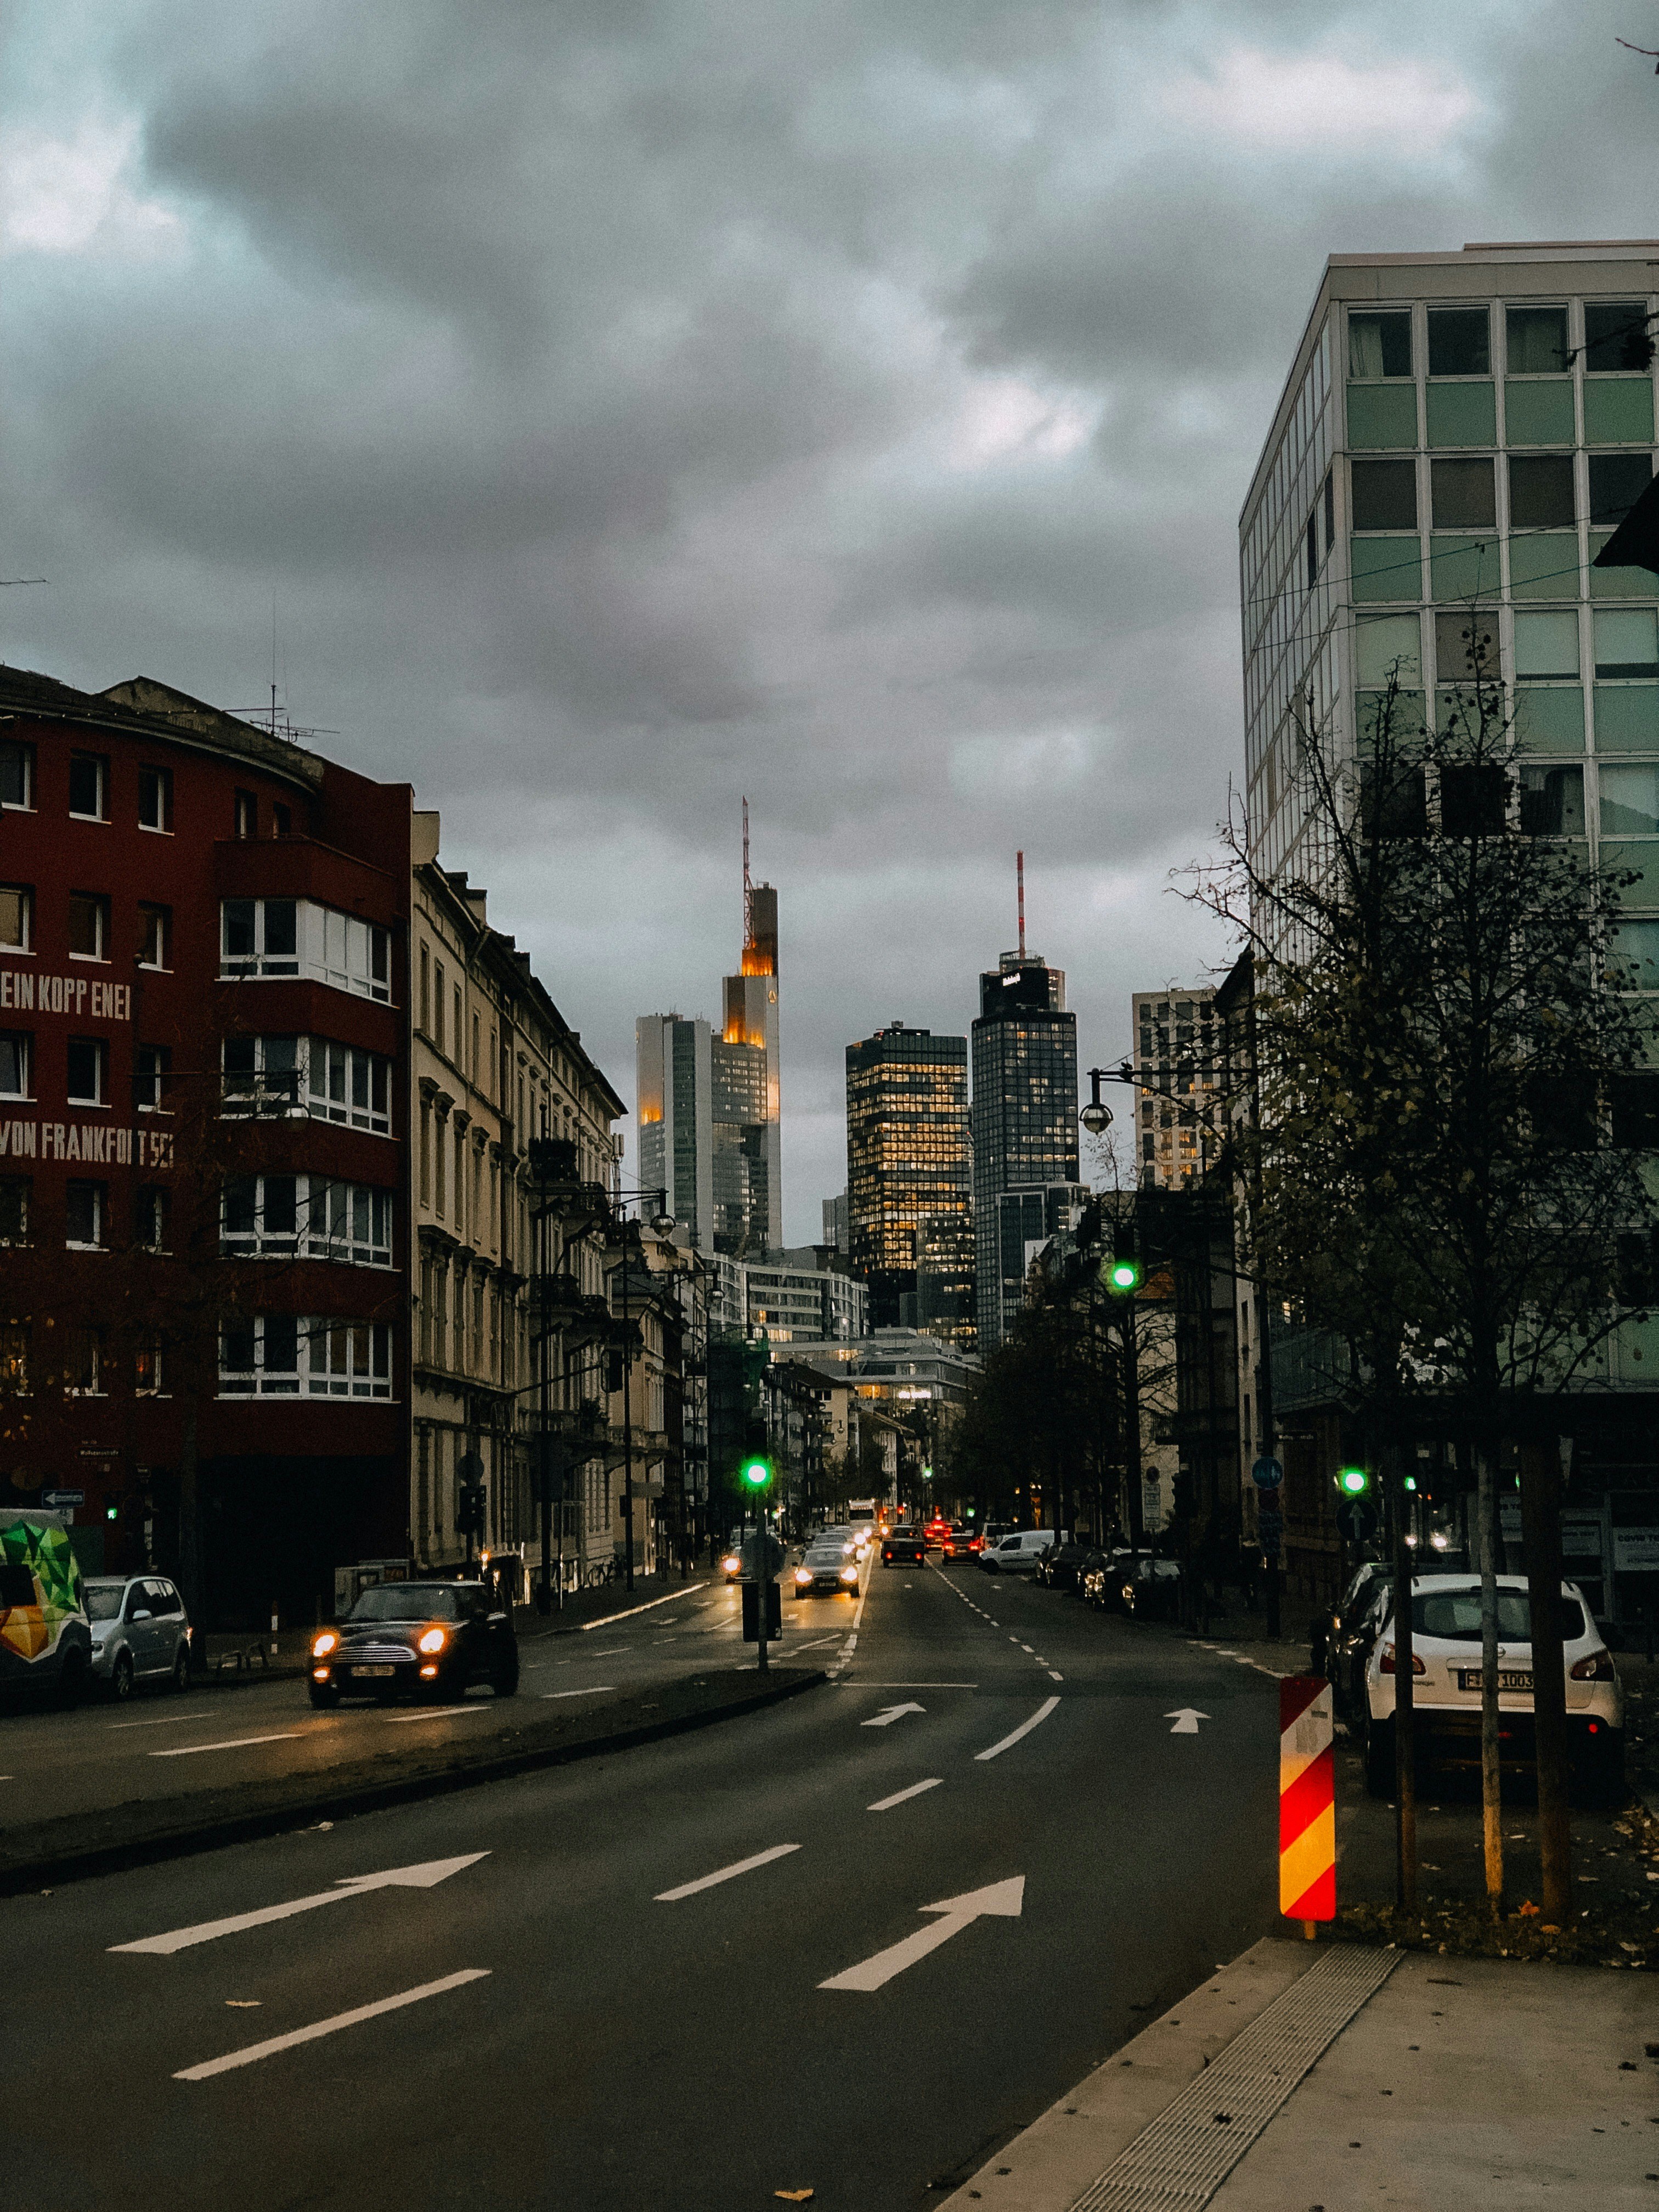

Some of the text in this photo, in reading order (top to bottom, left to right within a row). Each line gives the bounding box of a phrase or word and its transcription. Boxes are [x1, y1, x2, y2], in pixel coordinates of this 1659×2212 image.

[38, 974, 87, 1015] KOPP
[92, 980, 130, 1021] ENEI
[0, 1120, 36, 1158] VON
[1502, 1674, 1532, 1687] 1003
